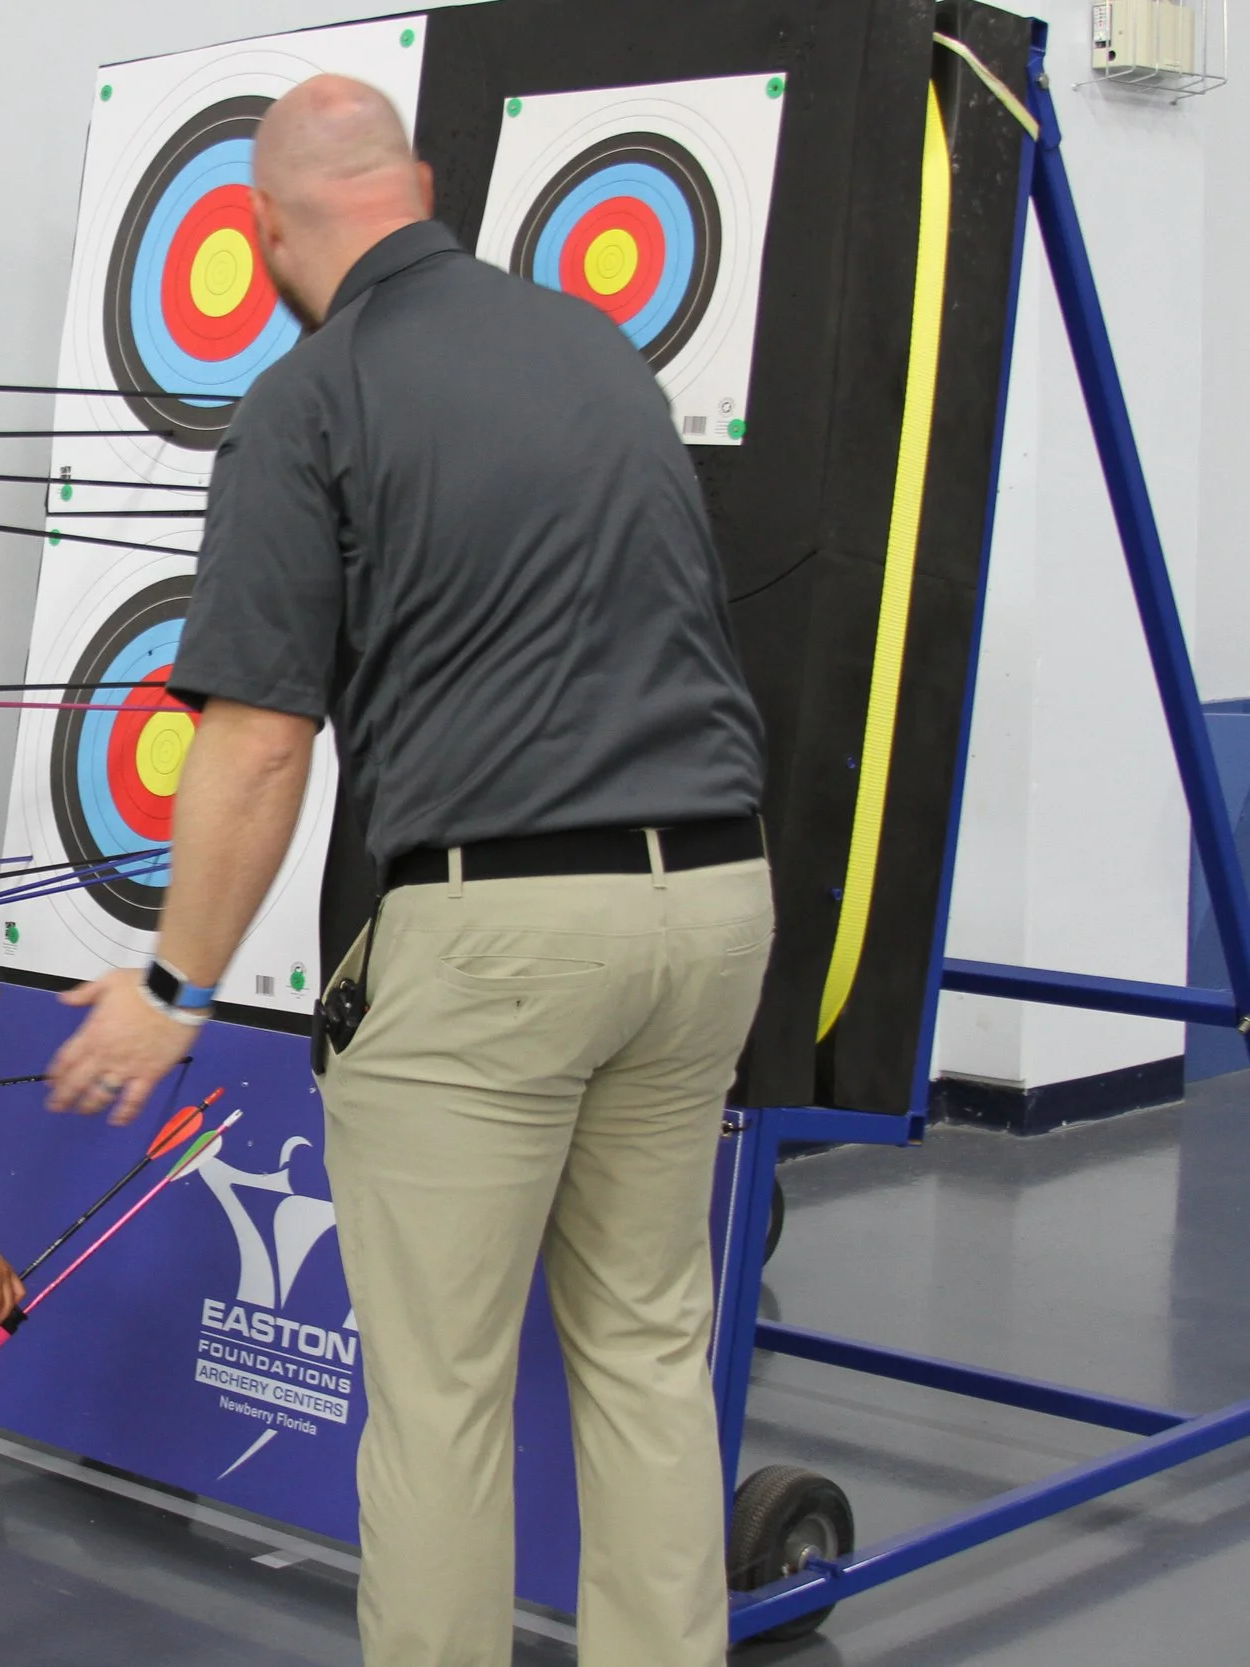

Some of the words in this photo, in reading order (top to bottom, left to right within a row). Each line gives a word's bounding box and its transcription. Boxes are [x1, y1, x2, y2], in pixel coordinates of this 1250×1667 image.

[202, 1298, 357, 1365] EASTON
[198, 1339, 351, 1394] FOUNDATIONS
[198, 1365, 268, 1396] ARCHERY
[272, 1386, 344, 1417] CENTERS
[219, 1395, 274, 1424] Newberry
[276, 1412, 317, 1435] Florida
